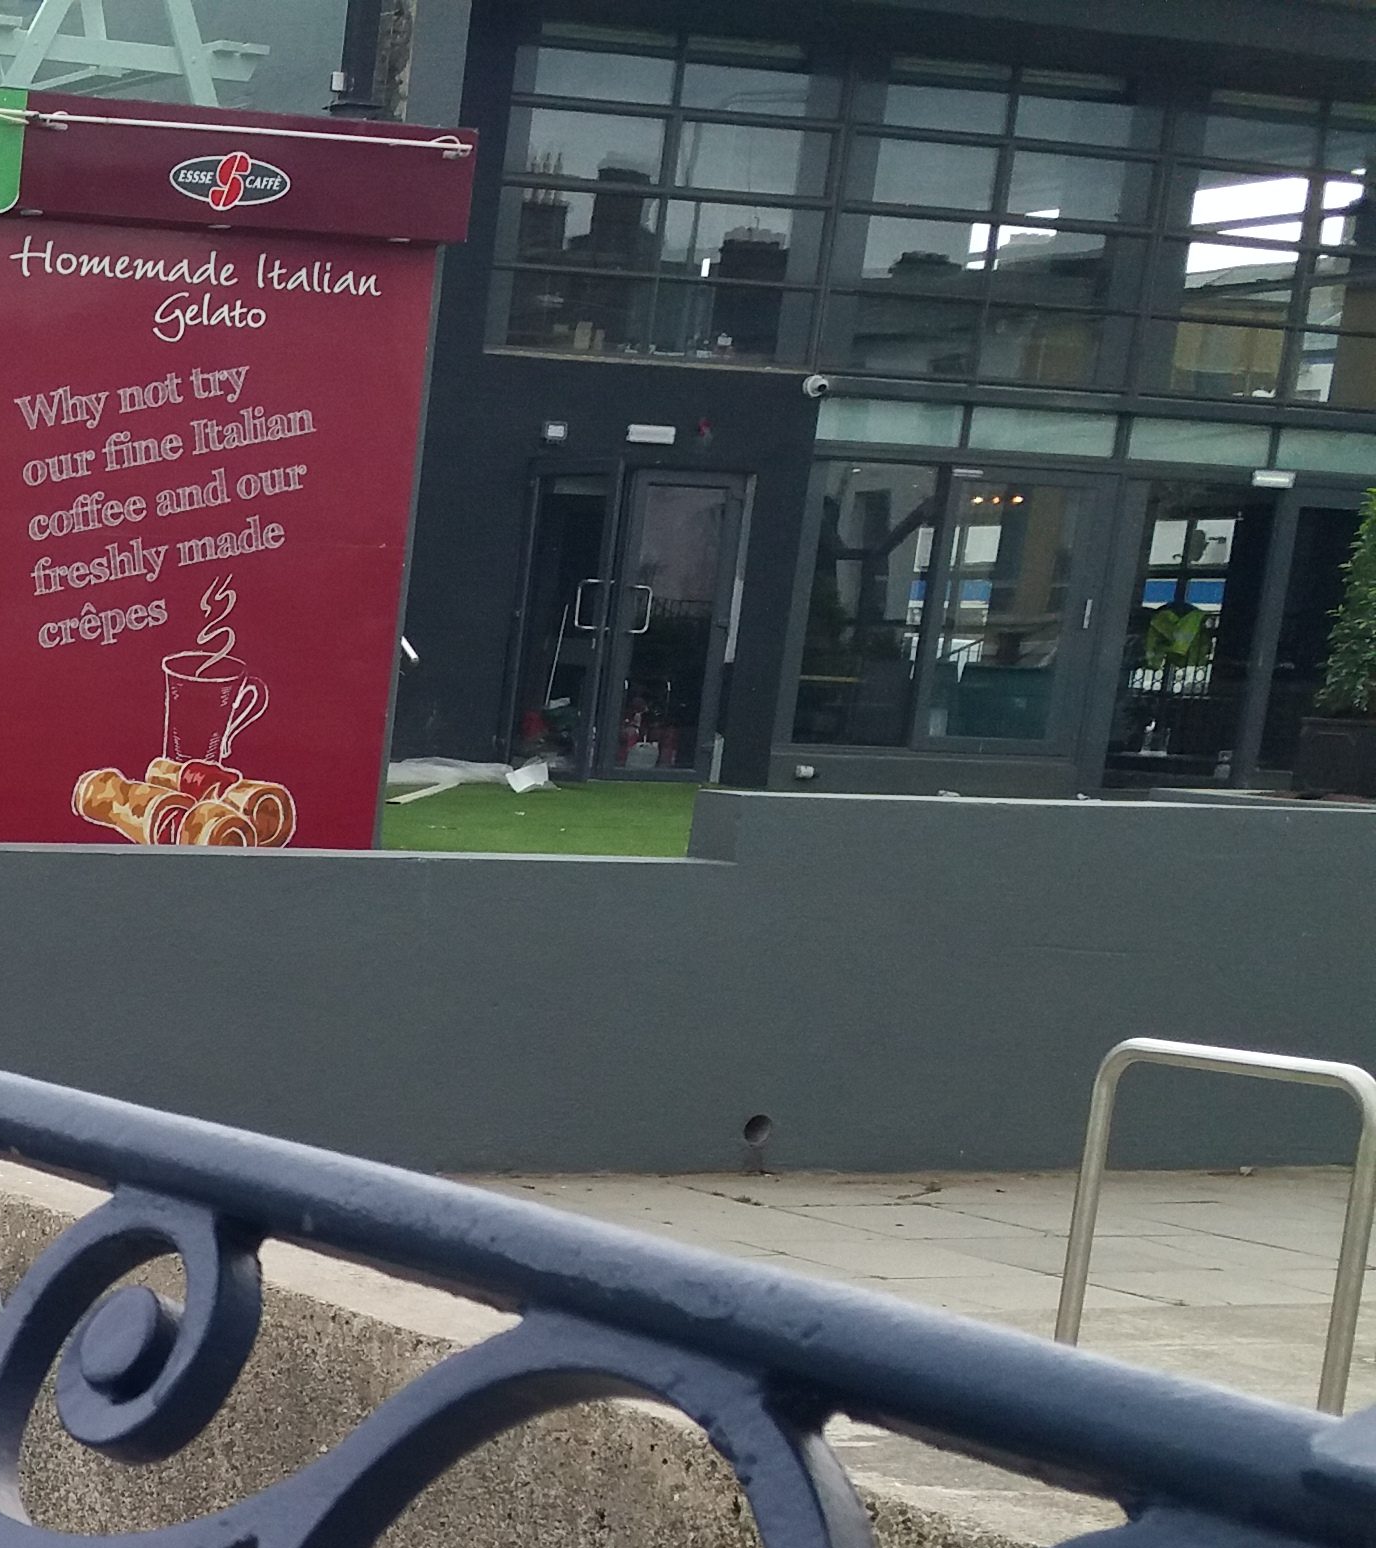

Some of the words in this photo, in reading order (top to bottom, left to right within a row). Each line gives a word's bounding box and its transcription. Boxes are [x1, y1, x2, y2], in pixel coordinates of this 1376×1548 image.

[177, 169, 215, 184] ESSSE
[245, 174, 283, 190] CAFFÈ
[9, 235, 239, 287] Homemade
[257, 253, 382, 297] Italian
[152, 292, 267, 343] Gelato
[14, 385, 109, 430] Why
[118, 372, 183, 414] not
[189, 365, 250, 403] try
[22, 449, 96, 487] our
[102, 431, 184, 472] fine
[190, 405, 317, 455] Italian
[28, 491, 147, 541] coffee
[156, 467, 231, 517] and
[236, 464, 308, 500] our
[30, 537, 169, 597] freshly
[177, 515, 286, 567] made
[38, 598, 168, 649] crêpes
